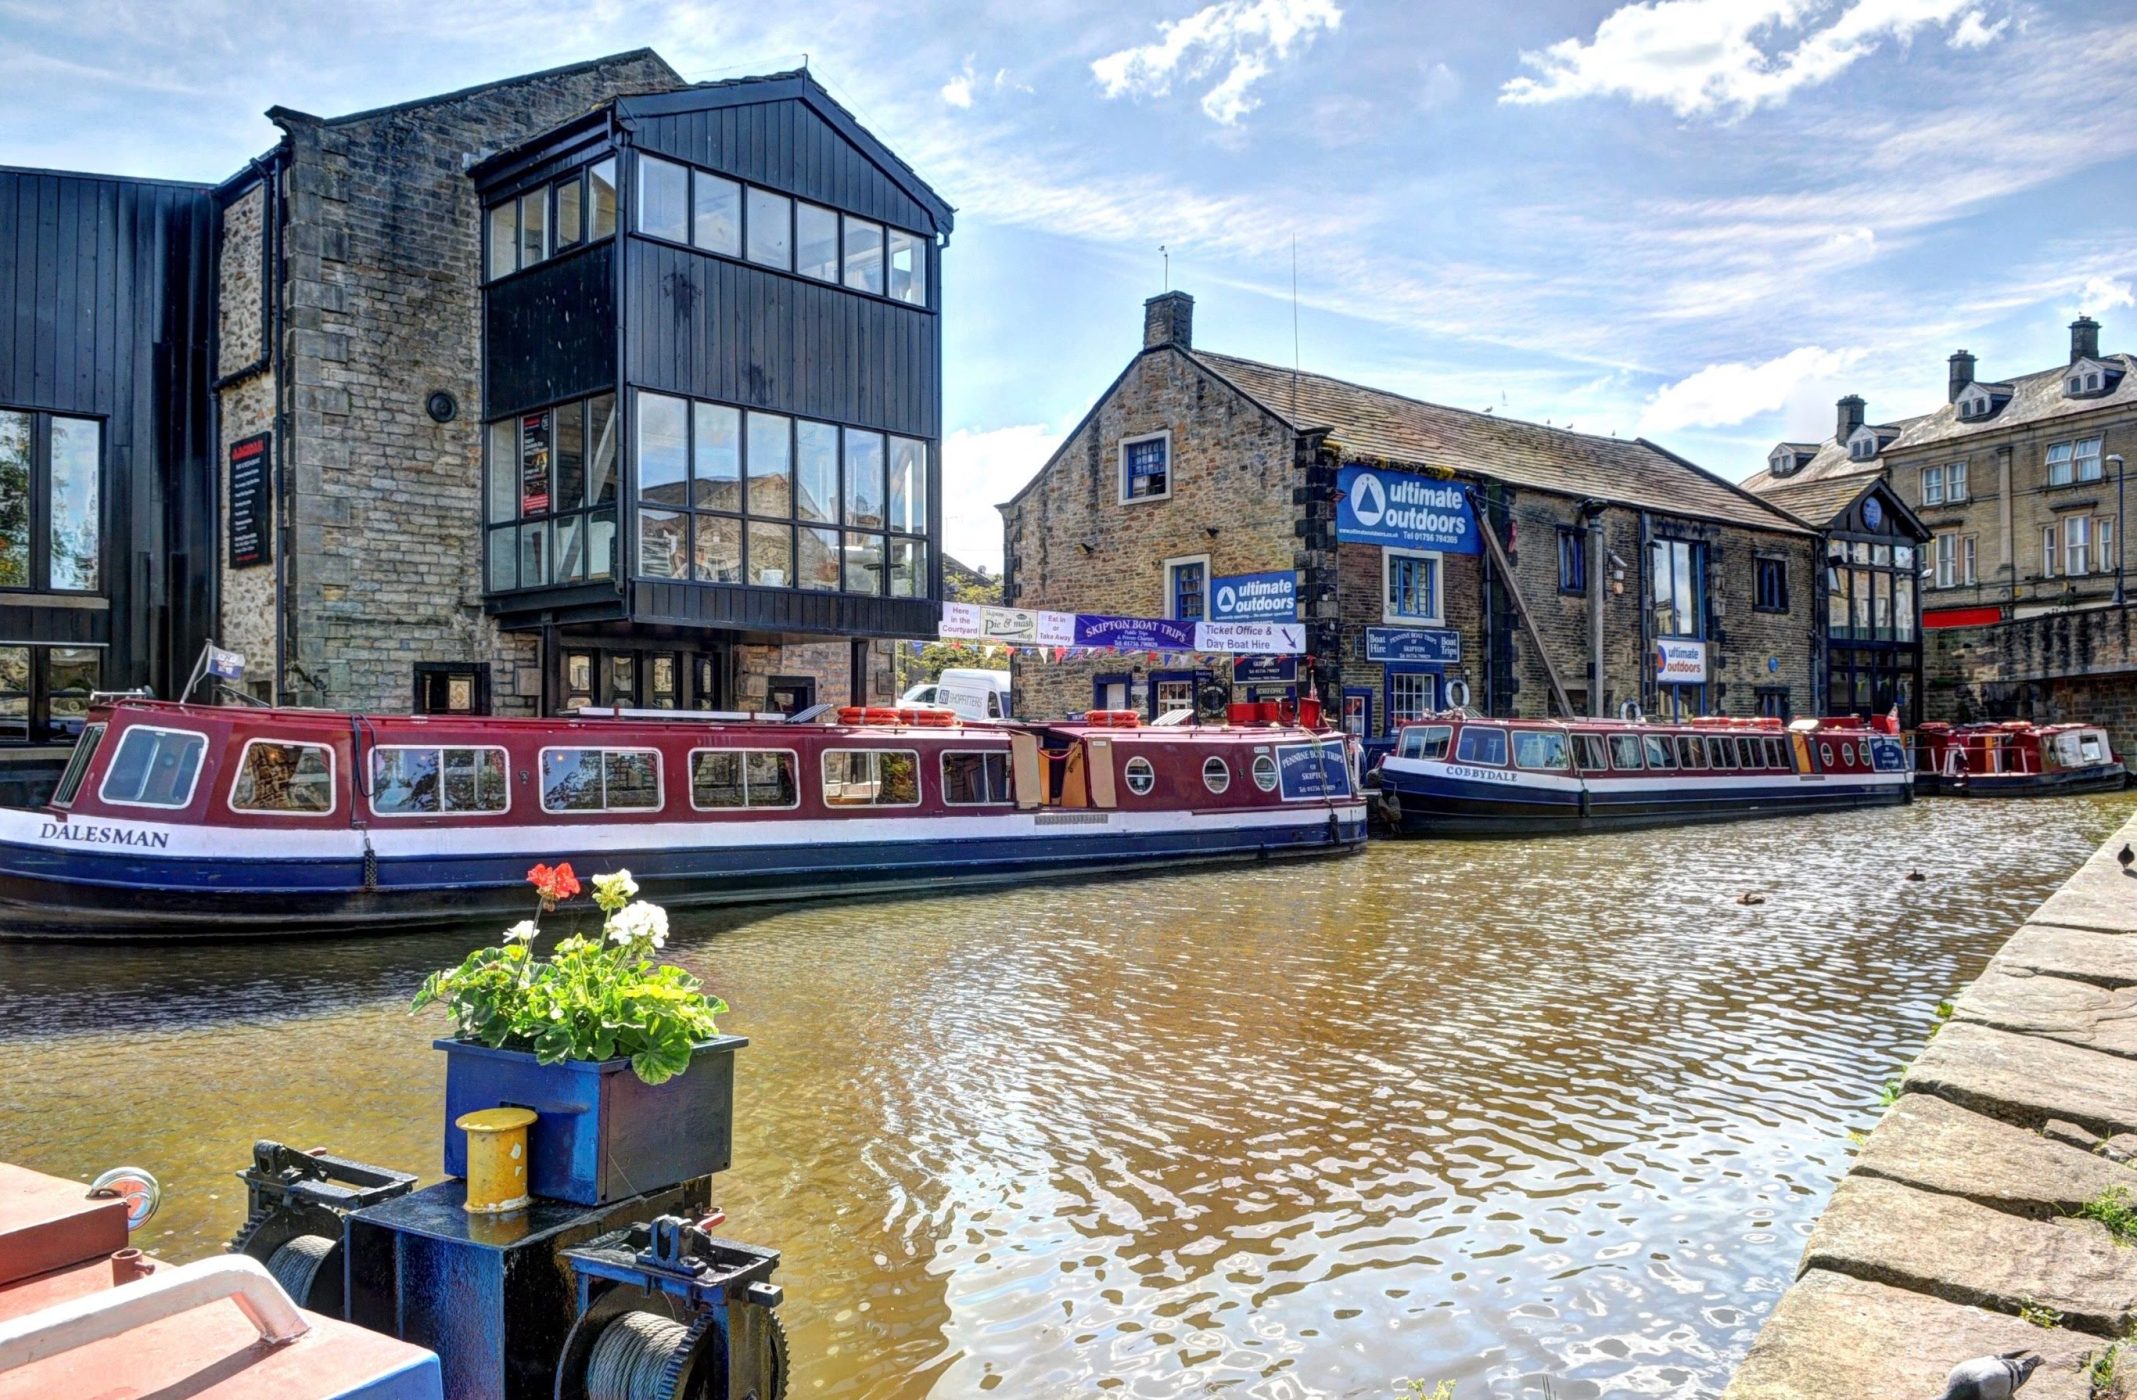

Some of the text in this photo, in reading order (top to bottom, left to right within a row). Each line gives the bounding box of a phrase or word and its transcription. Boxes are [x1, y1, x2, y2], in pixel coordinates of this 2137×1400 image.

[1390, 481, 1463, 509] ultimate
[1385, 507, 1466, 534] outdoors
[1403, 531, 1414, 540] Tel
[1414, 533, 1434, 542] 01756
[1239, 579, 1292, 597] ultimate
[952, 606, 969, 614] Here
[1236, 596, 1294, 613] outdoors
[942, 624, 978, 634] Courtyard
[1003, 618, 1012, 628] &
[1013, 618, 1033, 629] mash
[1085, 619, 1186, 642] SKIPTON BOAT TRIPS
[1206, 625, 1272, 635] Ticket Office &
[1018, 632, 1033, 640] shop
[1040, 632, 1054, 640] Take
[1369, 634, 1386, 644] Boat
[1424, 634, 1437, 645] TRIPS
[1441, 636, 1457, 646] Boat
[1206, 639, 1270, 650] Day Boat Hire
[1370, 644, 1386, 653] Hire
[1442, 646, 1457, 658] Trips
[1668, 646, 1699, 659] ultimate
[1667, 660, 1702, 673] outdoors
[950, 692, 983, 707] SHOPFITTERS
[1281, 750, 1309, 768] PENNINE
[1327, 751, 1344, 763] TRIPS
[1446, 766, 1518, 782] COBBYDALE
[39, 823, 169, 848] DALESMAN
